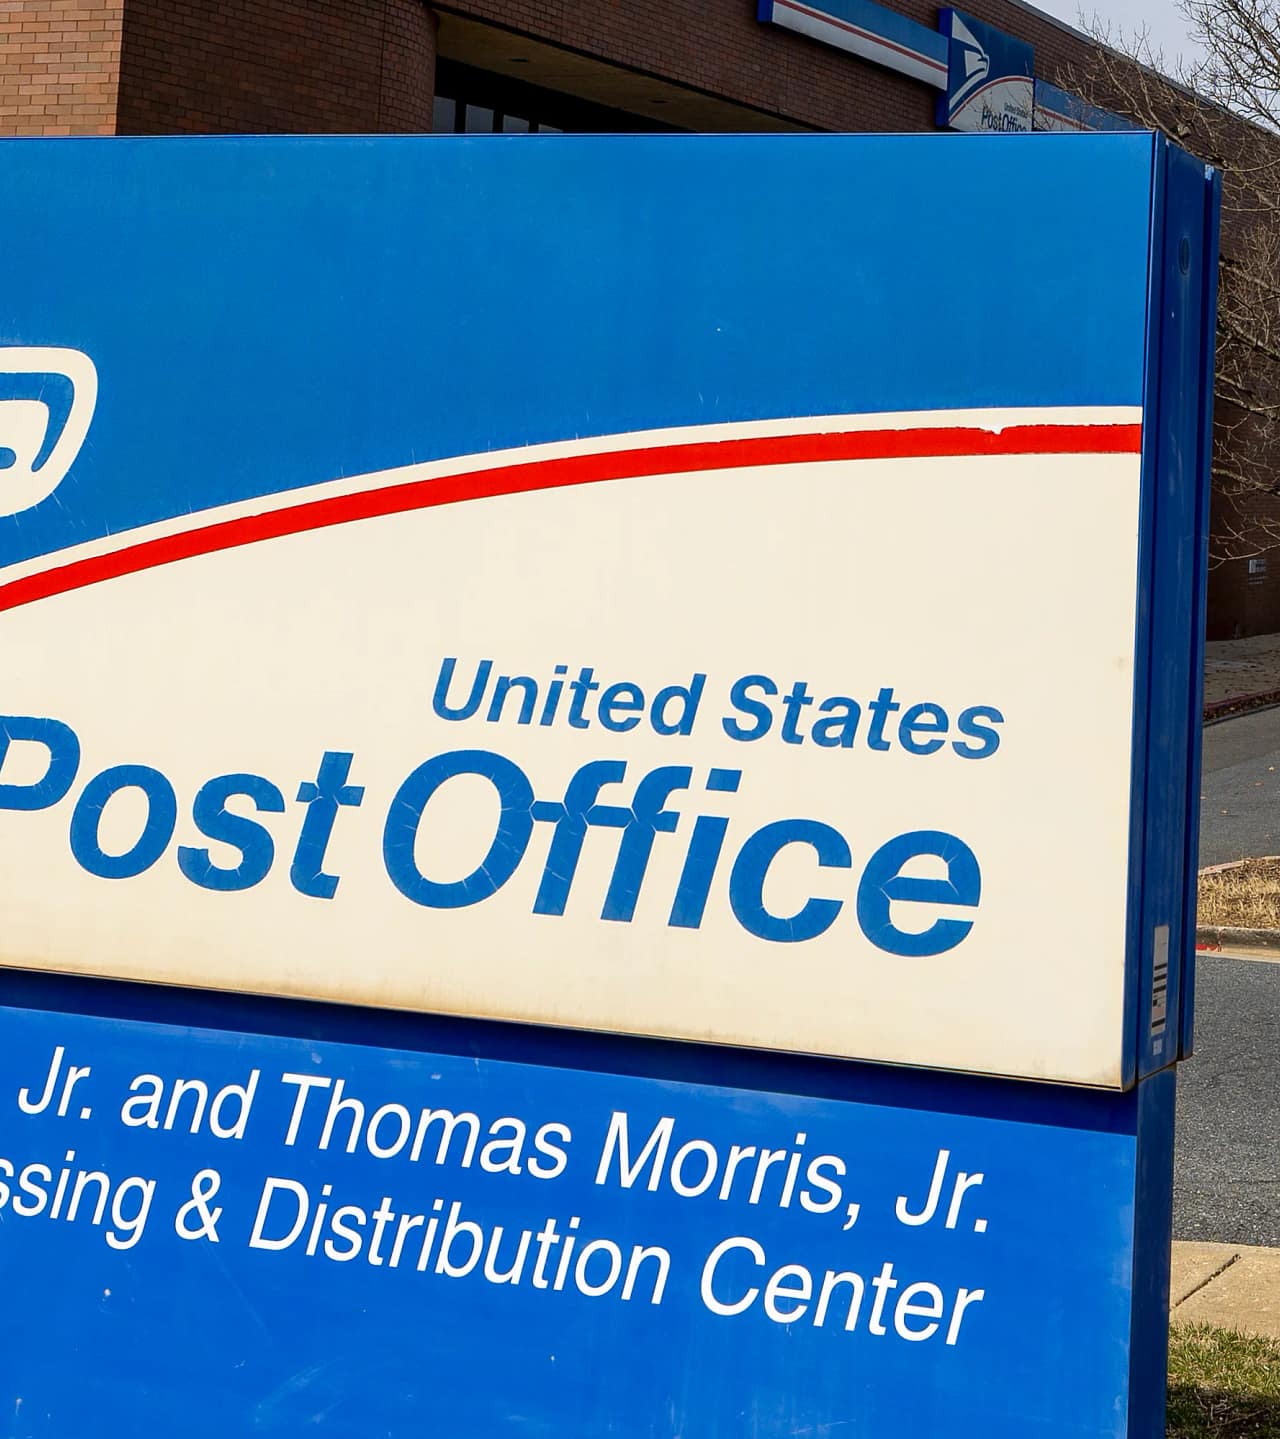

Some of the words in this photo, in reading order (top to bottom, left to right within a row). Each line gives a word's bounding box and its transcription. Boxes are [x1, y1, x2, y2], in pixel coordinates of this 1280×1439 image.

[981, 105, 1002, 131] Post
[432, 657, 708, 737] United
[722, 674, 1005, 760] States
[382, 749, 982, 957] Office
[18, 1046, 93, 1120] Jr.
[121, 1069, 261, 1140] and
[281, 1072, 572, 1180] Thomas
[595, 1111, 861, 1232] Morris,
[895, 1149, 991, 1234] Jr.
[175, 1167, 224, 1244] &
[249, 1177, 672, 1306] Distribution
[699, 1236, 986, 1347] Center
